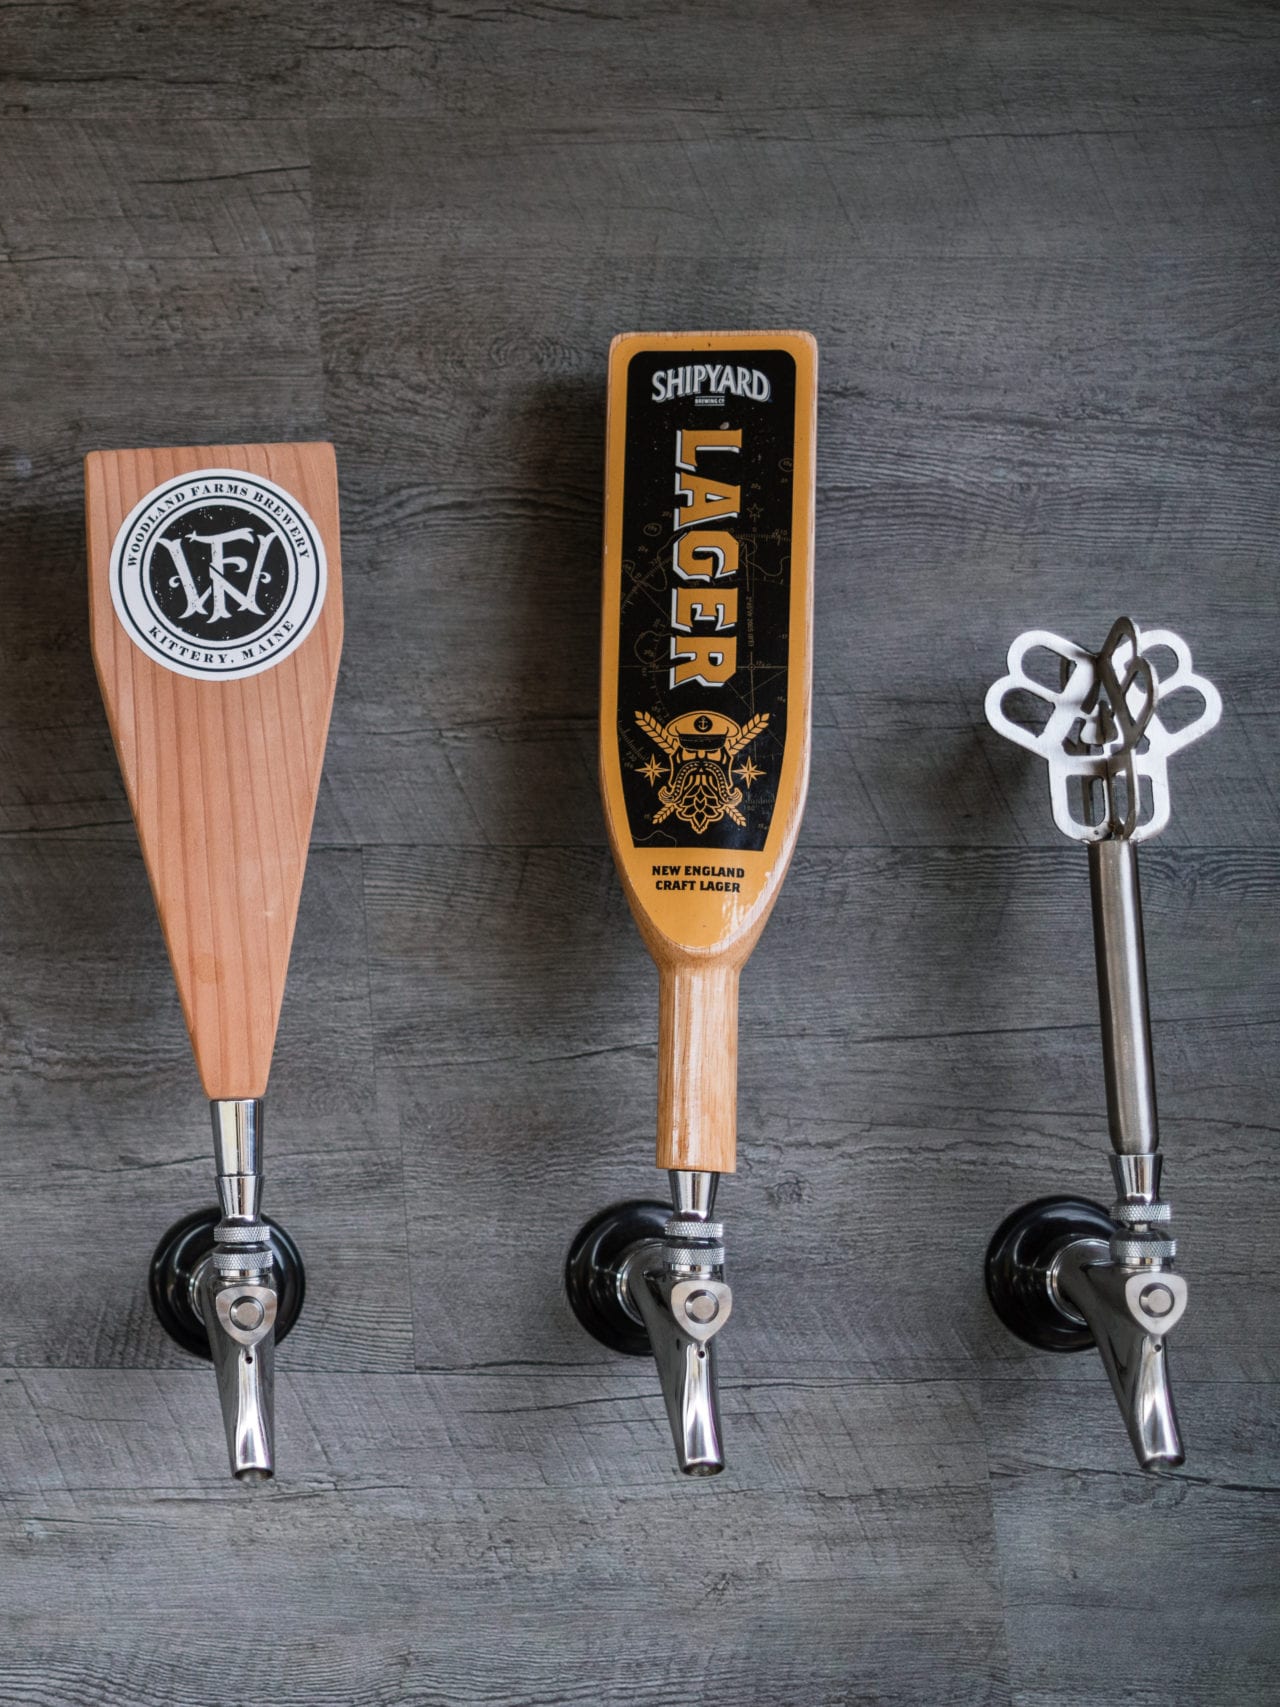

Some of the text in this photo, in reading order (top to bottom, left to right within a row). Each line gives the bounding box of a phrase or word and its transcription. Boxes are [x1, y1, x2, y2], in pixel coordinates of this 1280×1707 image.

[651, 364, 771, 403] SHIPYARD
[127, 483, 310, 567] WOODLAND FARMS BREWERY
[669, 428, 742, 690] LAGER
[242, 620, 294, 661] MAINE
[652, 865, 745, 878] NEW ENGLAND
[655, 880, 741, 893] CRAFT LAGER
